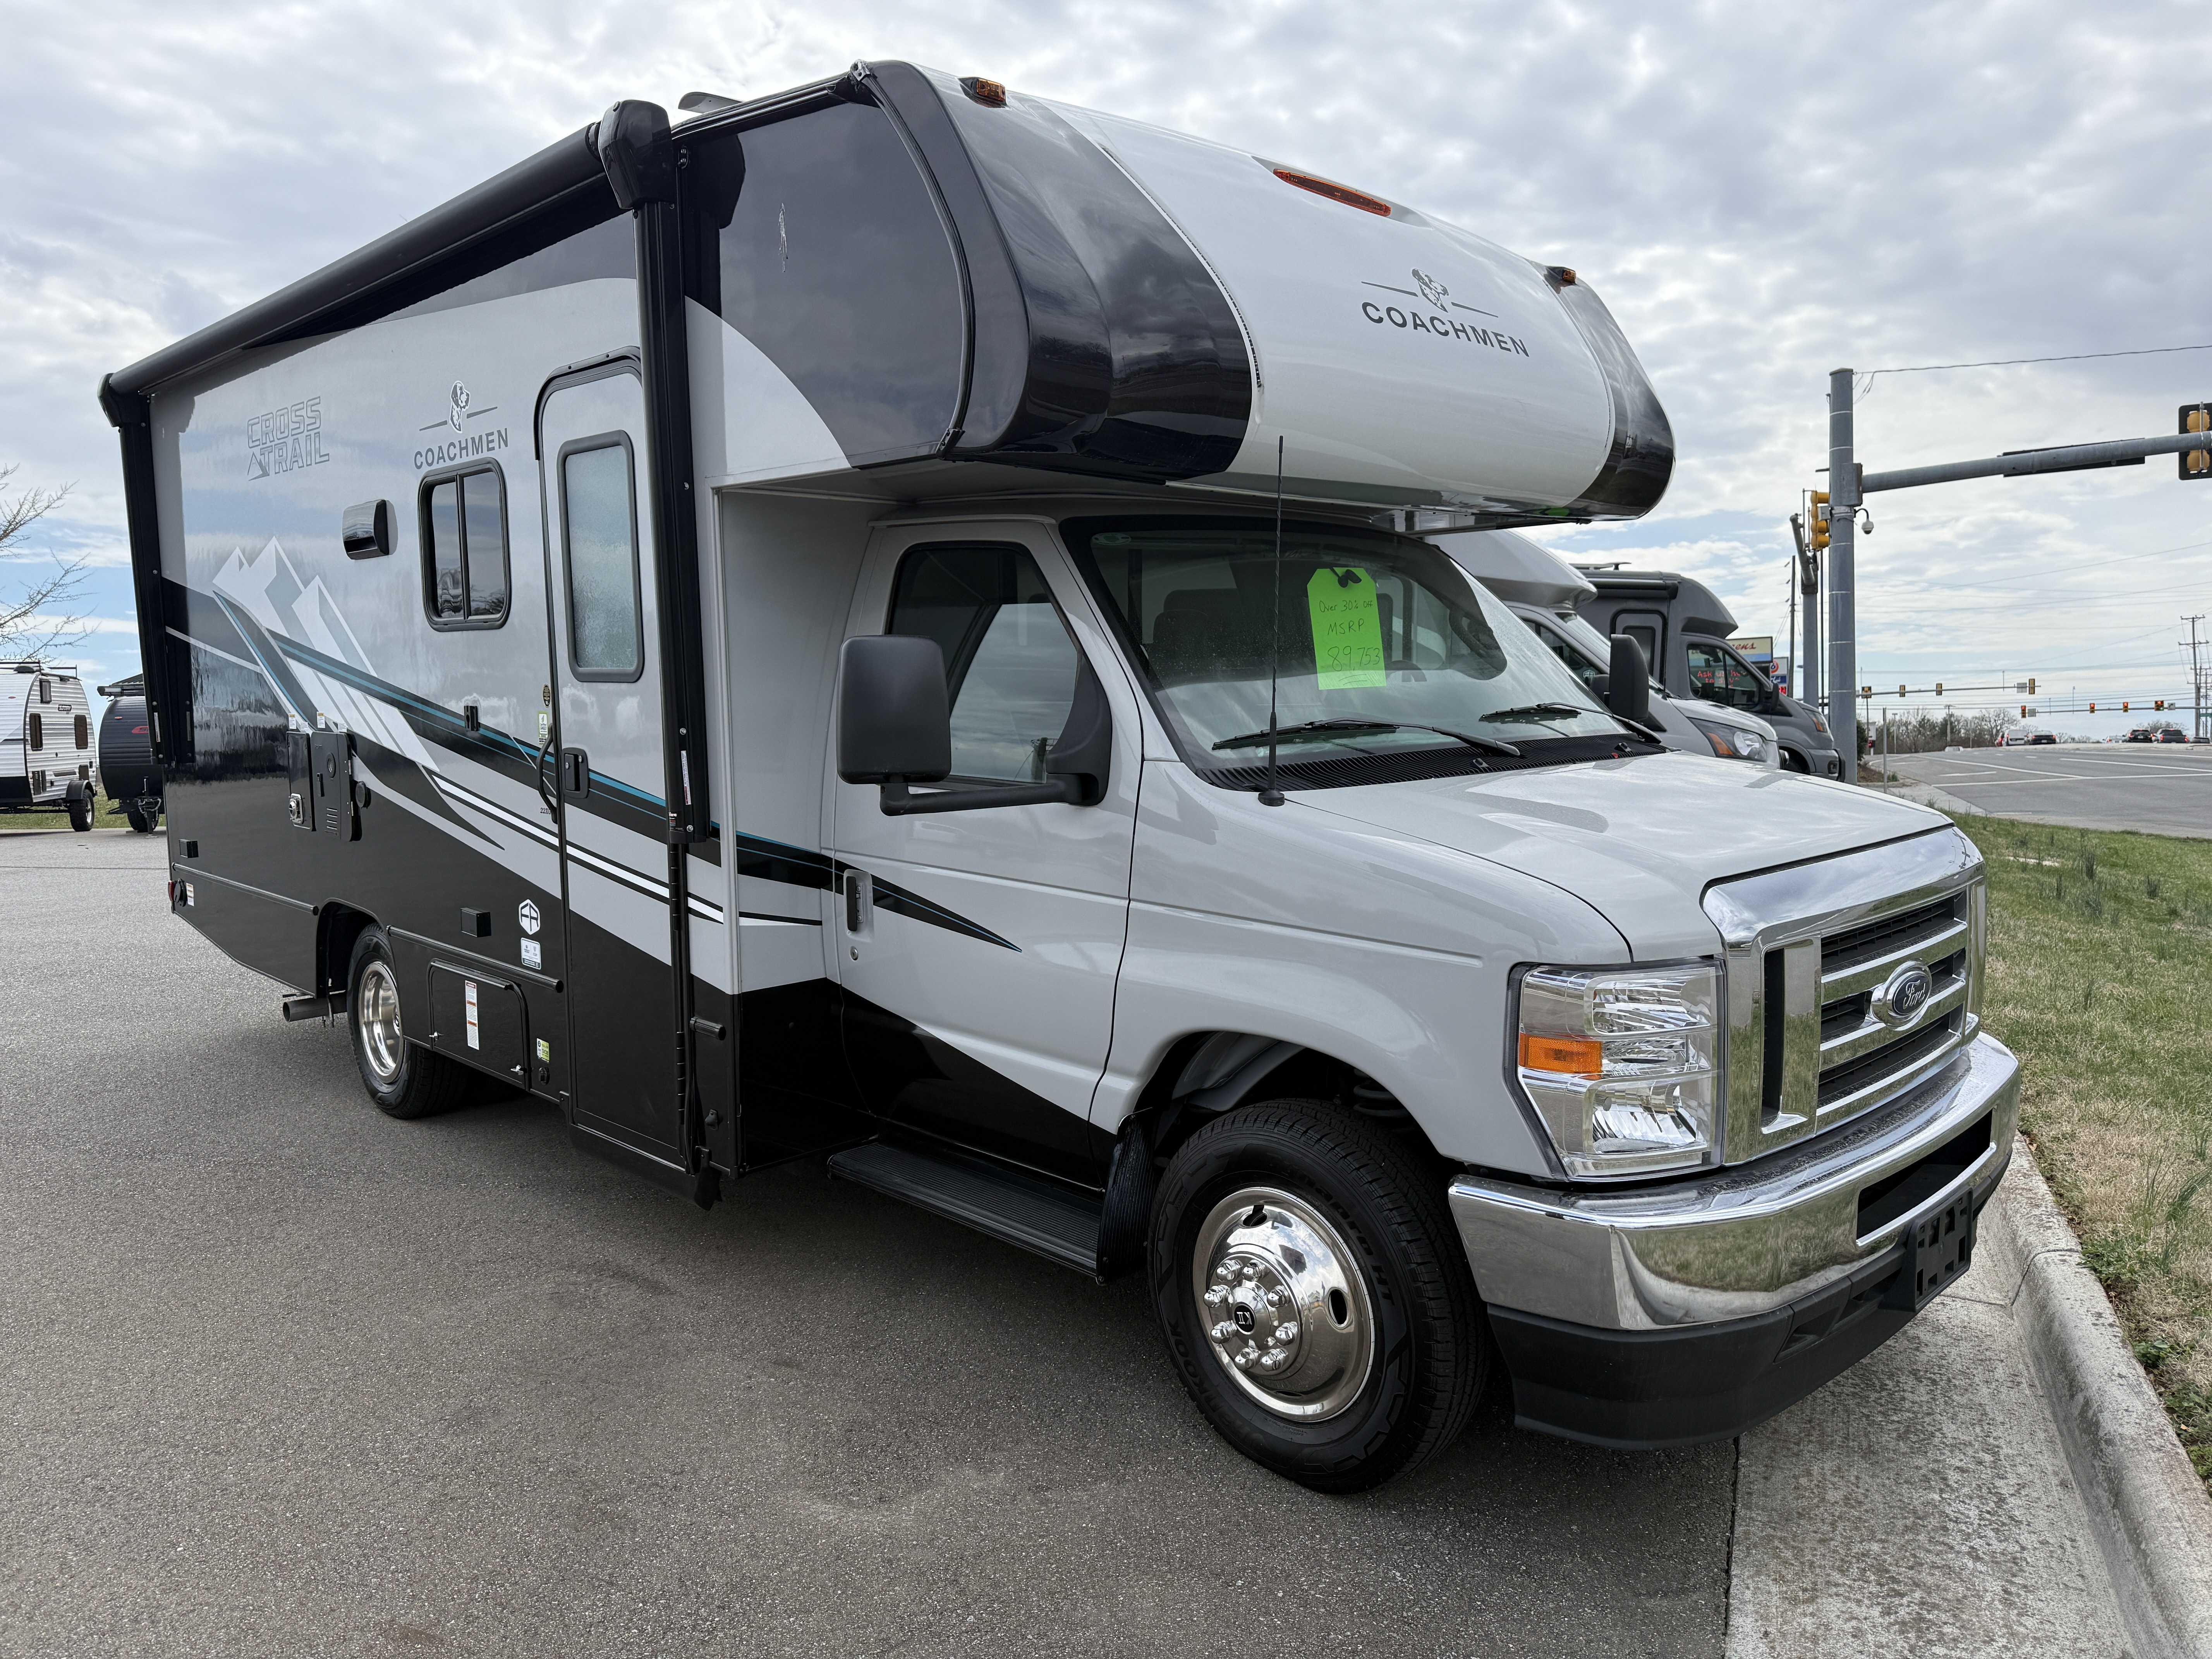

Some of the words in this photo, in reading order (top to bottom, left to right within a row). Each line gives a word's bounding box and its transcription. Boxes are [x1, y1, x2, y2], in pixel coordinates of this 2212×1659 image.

[1362, 301, 1530, 357] COACHMEN
[247, 396, 322, 449] CROSS
[259, 431, 330, 475] TRAIL
[414, 428, 508, 470] COACHMEN
[1319, 600, 1338, 613] Over
[1341, 599, 1358, 612] 30%
[1327, 618, 1365, 635] MSRP
[1327, 646, 1380, 672] 89,753
[1903, 979, 1926, 1010] Ford
